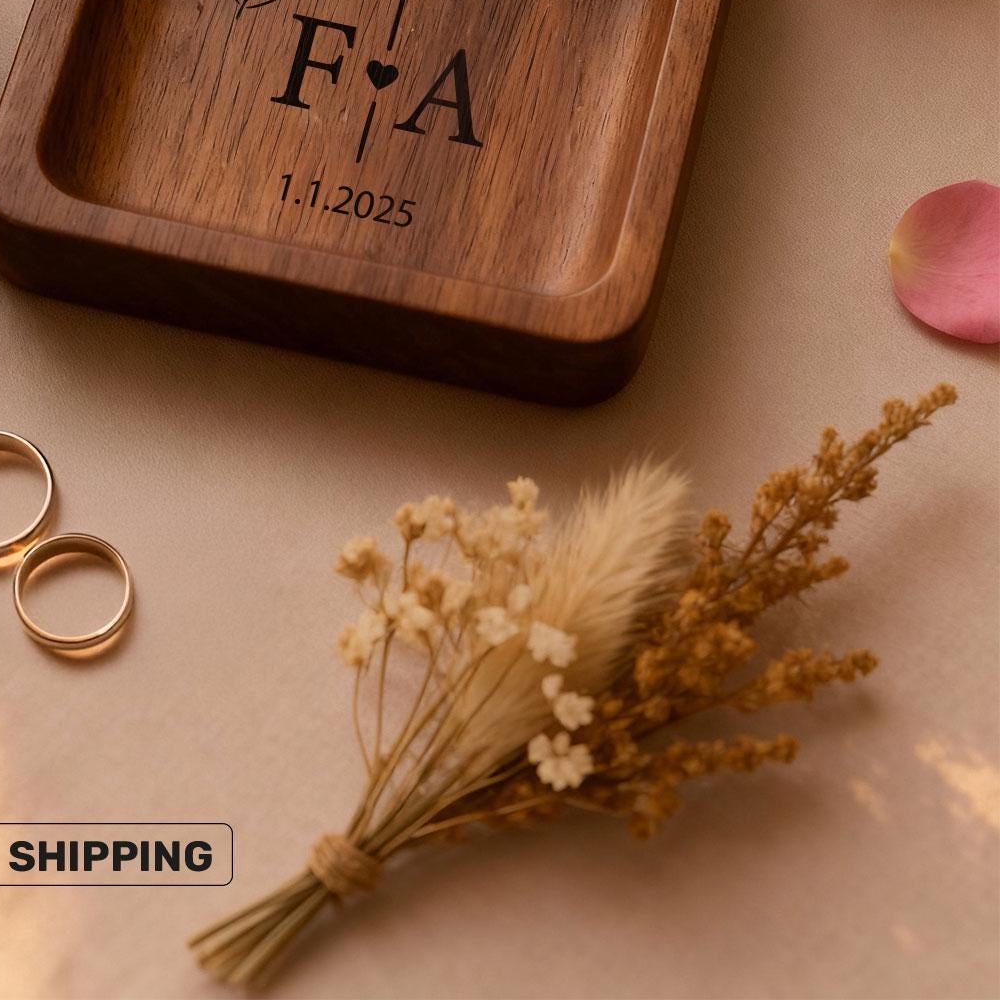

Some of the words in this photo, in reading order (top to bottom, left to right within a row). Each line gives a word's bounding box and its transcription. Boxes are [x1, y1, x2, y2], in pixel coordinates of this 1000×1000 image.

[270, 13, 357, 109] F
[393, 49, 483, 147] A
[281, 174, 416, 227] 1.1.2025
